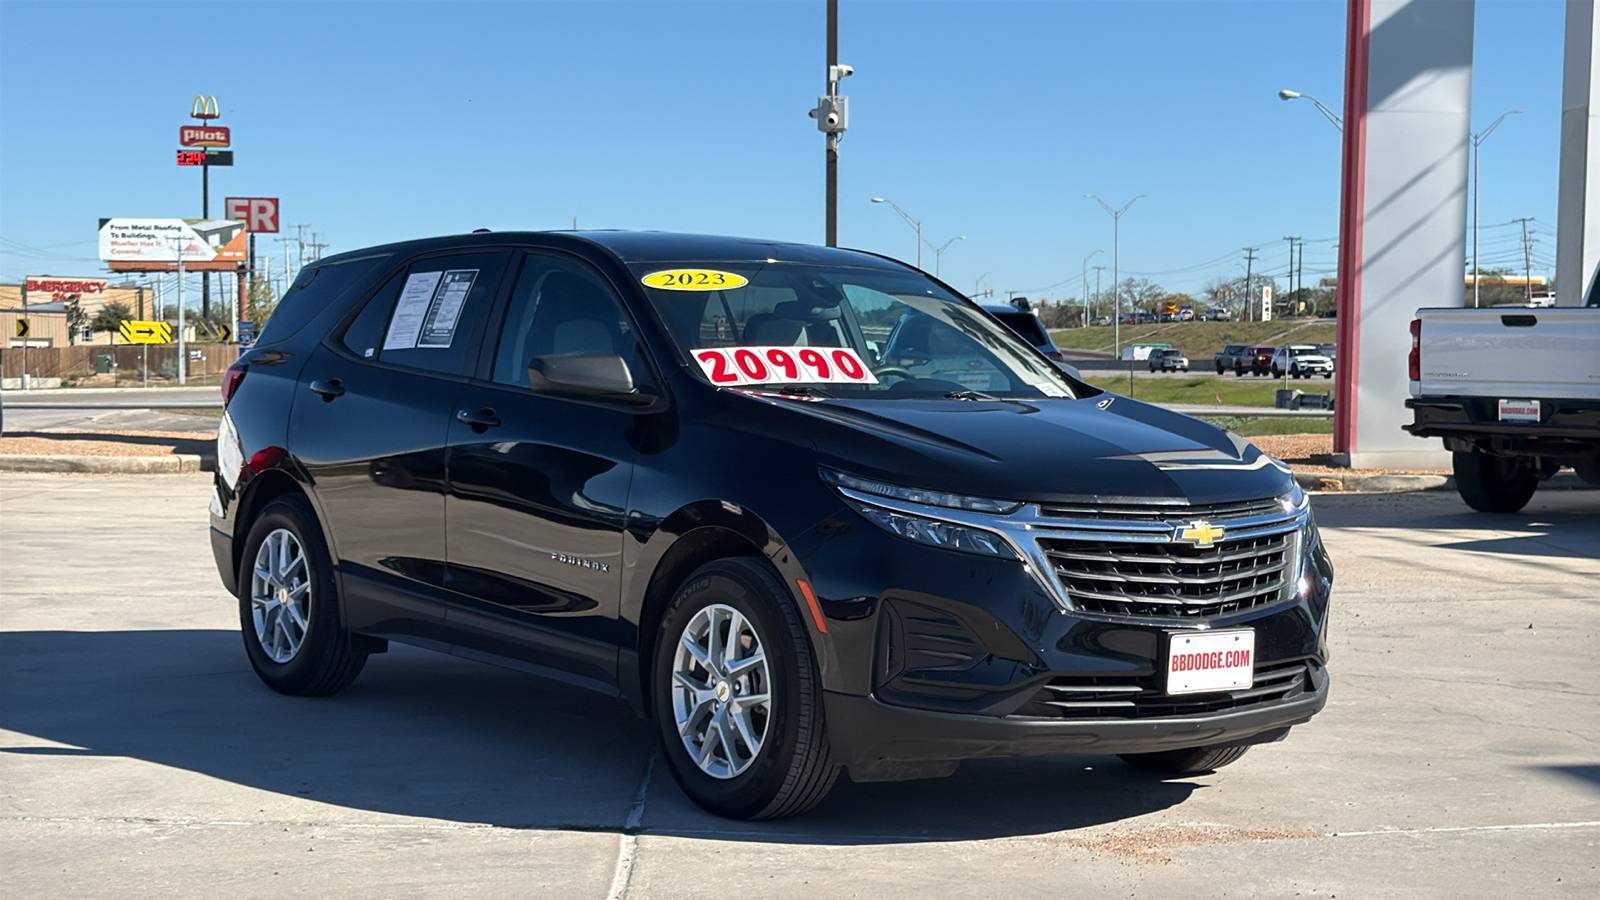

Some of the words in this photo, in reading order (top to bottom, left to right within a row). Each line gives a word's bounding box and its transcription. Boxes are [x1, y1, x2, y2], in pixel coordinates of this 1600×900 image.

[183, 129, 226, 142] Pilot
[227, 199, 276, 231] ER
[153, 224, 182, 233] Roofing
[26, 280, 108, 293] EMERGENCY
[662, 273, 726, 286] 2023
[697, 349, 868, 383] 20990
[551, 552, 609, 573] EQUINOX
[1171, 649, 1250, 672] BBDODGE.COM
